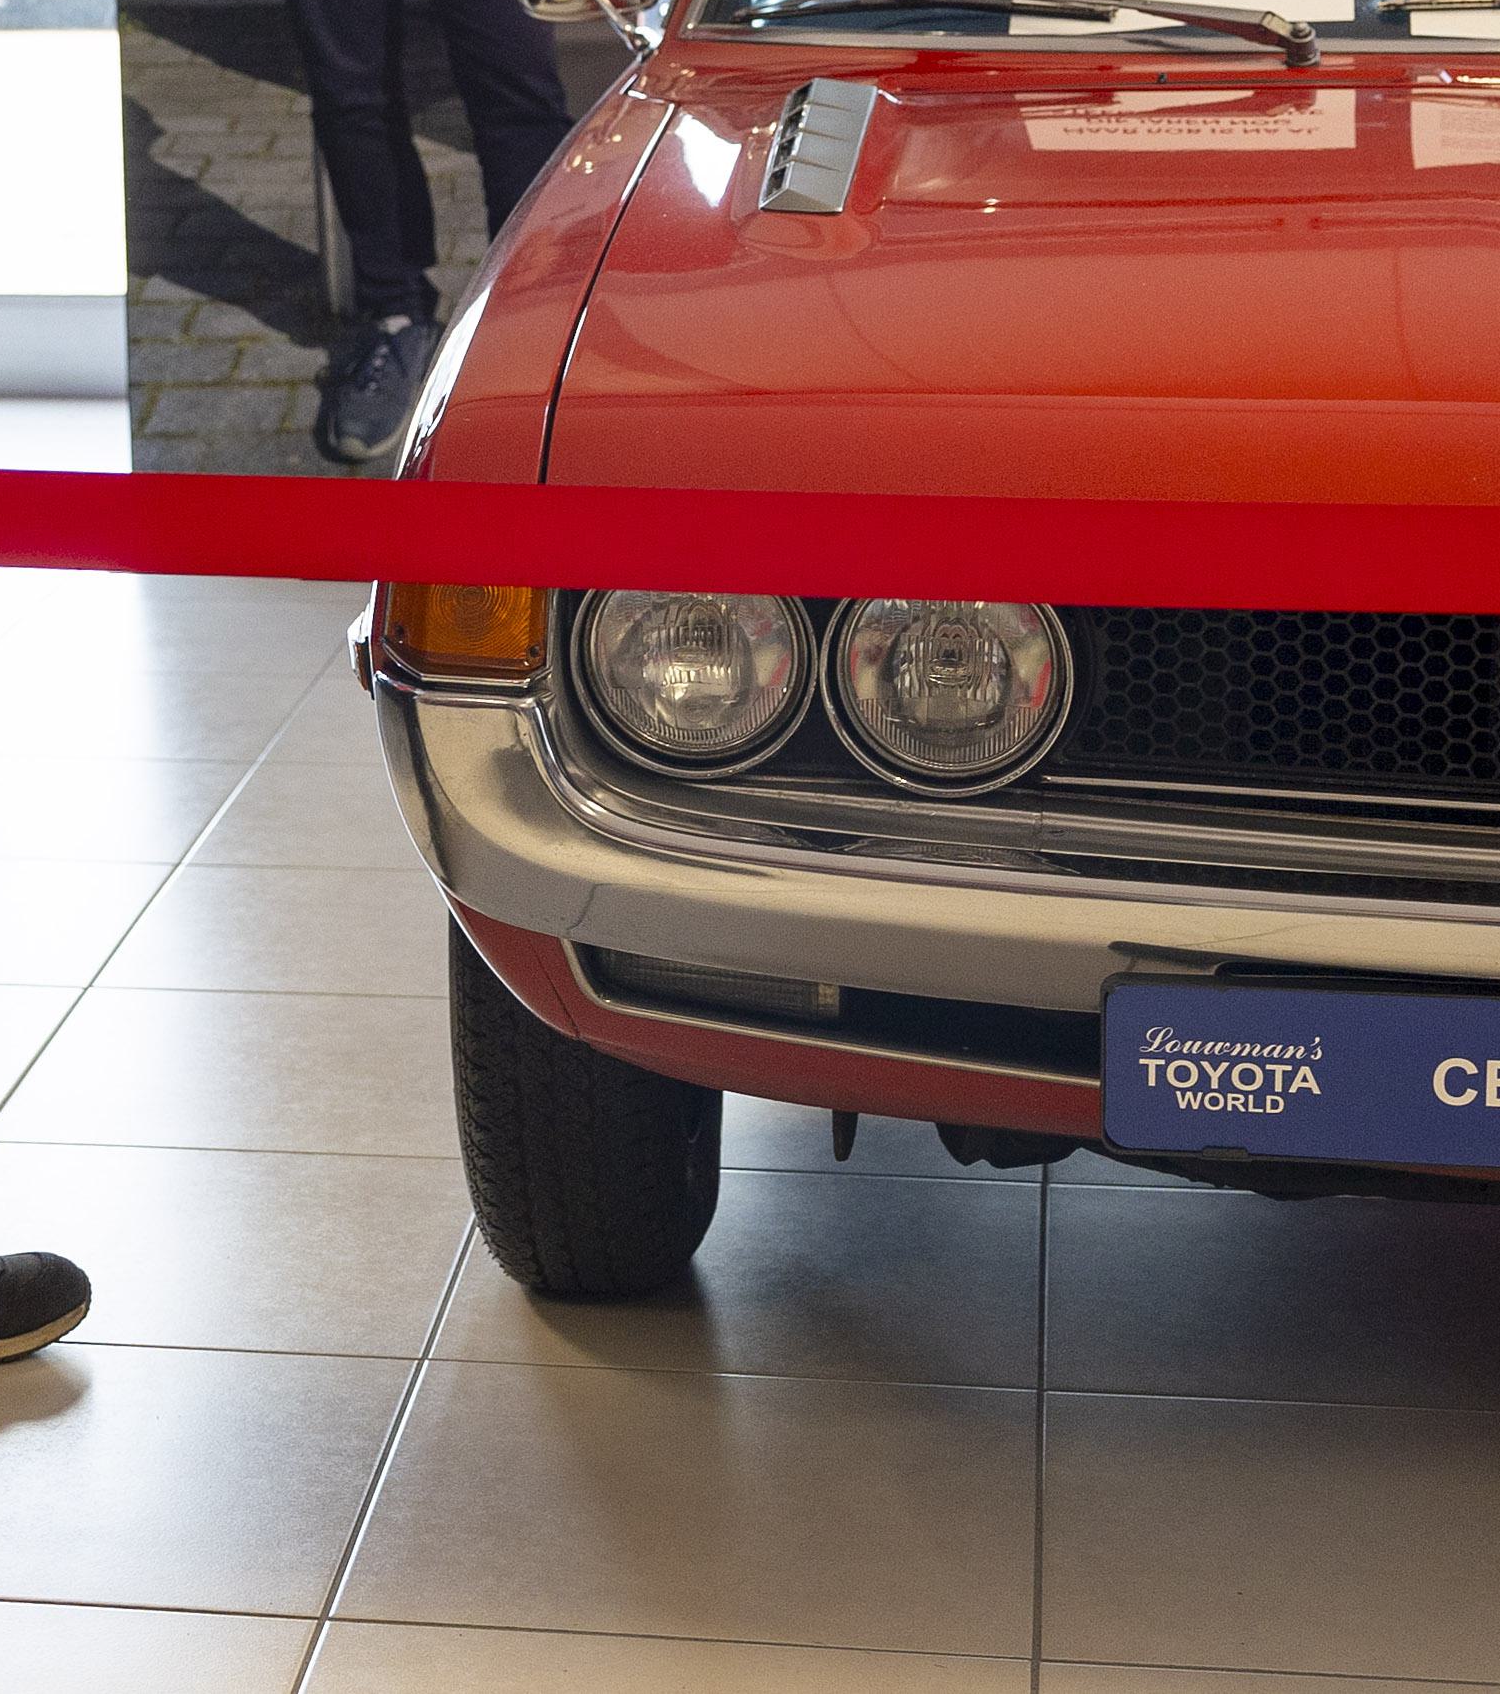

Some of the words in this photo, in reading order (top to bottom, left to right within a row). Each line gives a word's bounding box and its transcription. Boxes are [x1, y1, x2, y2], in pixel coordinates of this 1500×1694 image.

[1139, 1024, 1325, 1063] Louwman's
[1139, 1057, 1322, 1097] TOYOTA
[1175, 1089, 1286, 1115] WORLD
